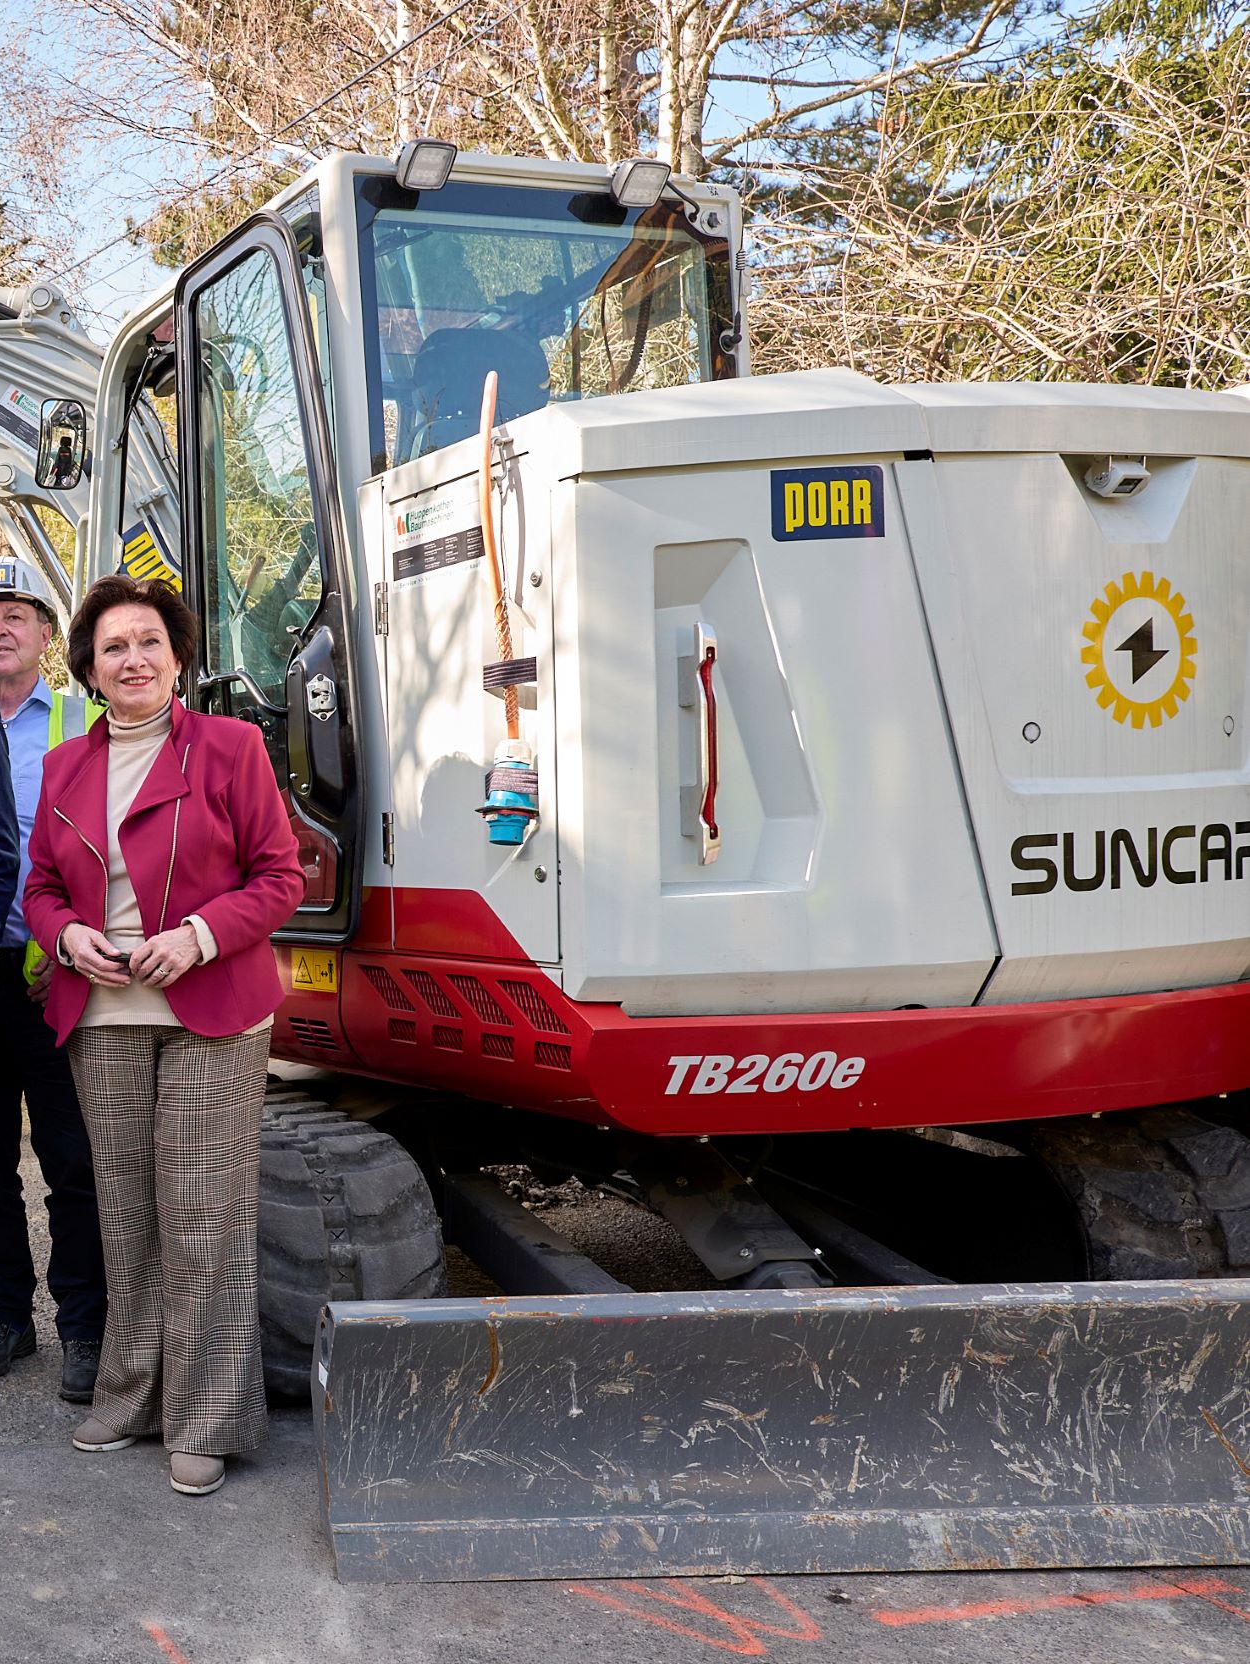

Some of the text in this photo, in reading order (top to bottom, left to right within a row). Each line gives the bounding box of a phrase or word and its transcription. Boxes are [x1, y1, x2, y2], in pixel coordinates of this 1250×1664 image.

[784, 479, 872, 533] PORR
[123, 531, 182, 593] POR
[664, 1051, 866, 1095] TB260e
